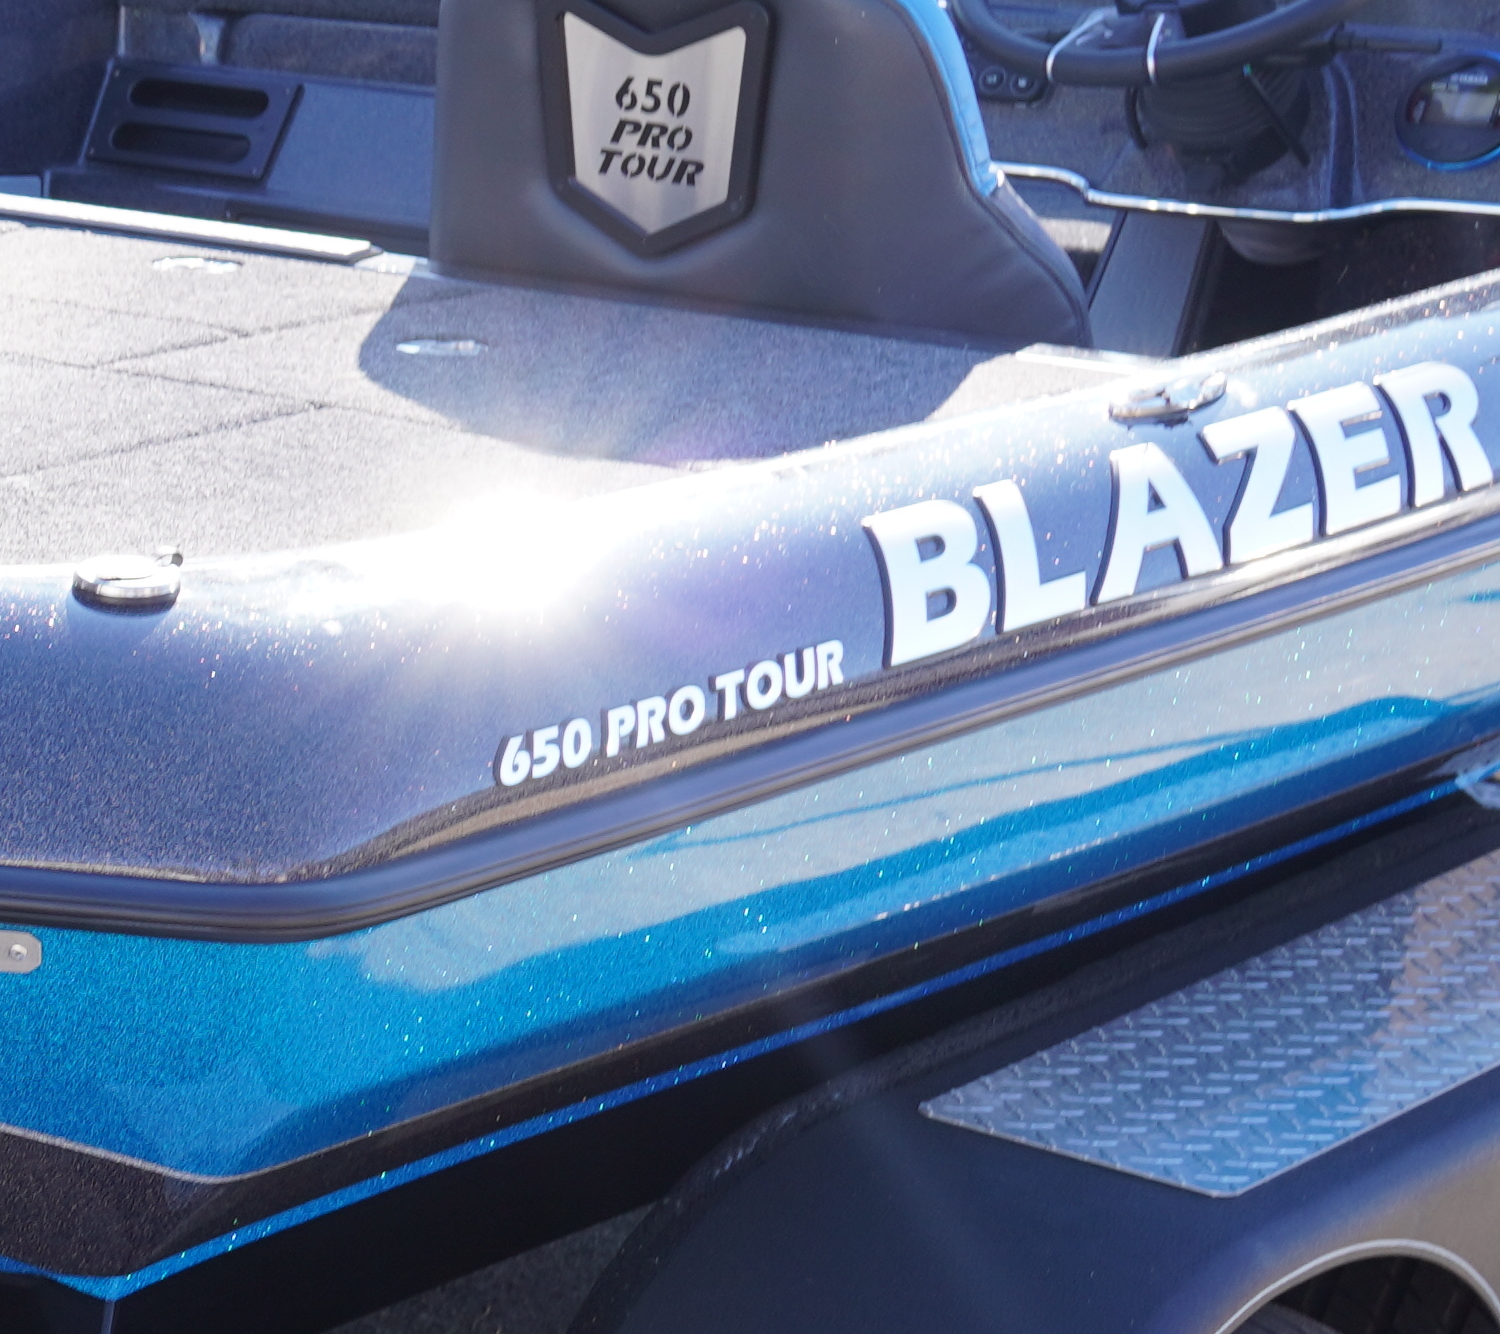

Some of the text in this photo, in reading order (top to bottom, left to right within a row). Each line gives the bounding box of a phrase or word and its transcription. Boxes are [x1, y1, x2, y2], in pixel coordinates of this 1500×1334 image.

[615, 76, 690, 117] 650
[610, 118, 693, 151] PRO
[599, 148, 704, 187] TOUR
[861, 361, 1495, 667] BLAZER
[495, 639, 844, 787] 650 PRO TOUR
